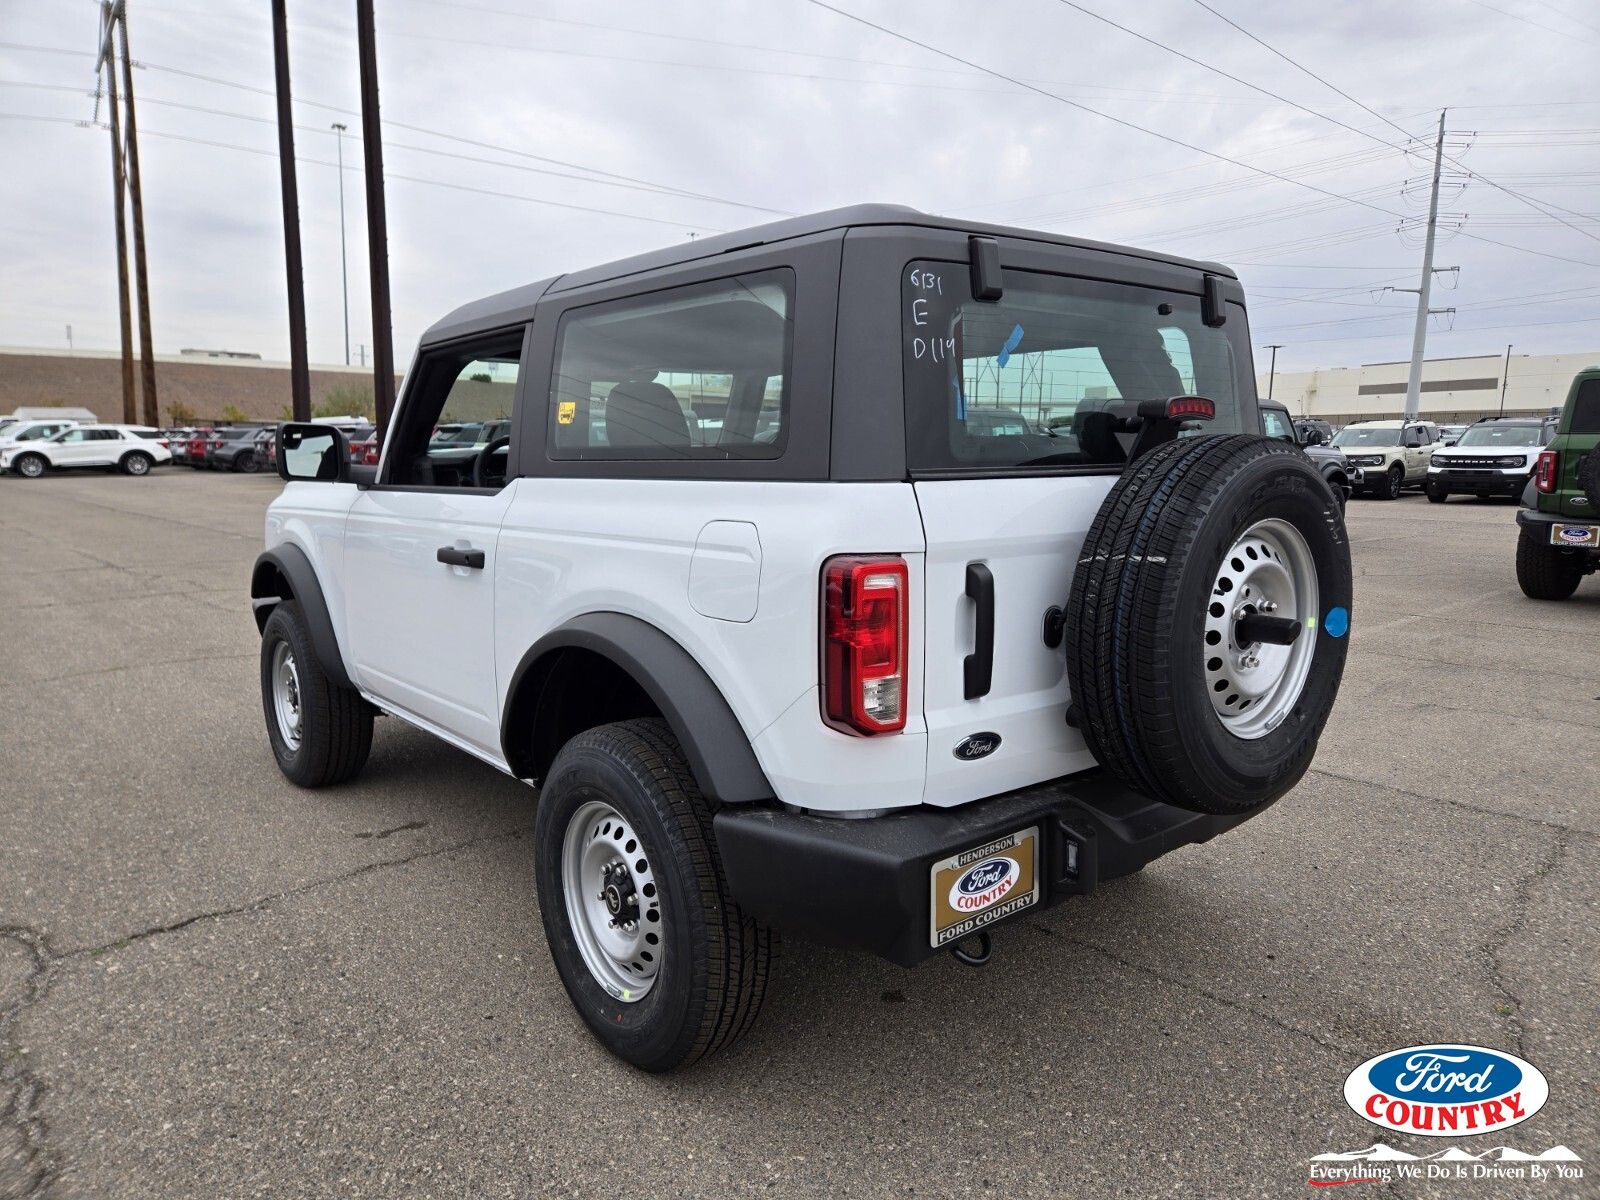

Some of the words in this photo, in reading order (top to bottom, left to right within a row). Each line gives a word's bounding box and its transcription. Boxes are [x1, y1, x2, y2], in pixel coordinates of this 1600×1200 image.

[911, 270, 942, 295] 6131
[912, 299, 928, 326] E
[966, 740, 992, 756] Ford
[959, 838, 1014, 865] HENDERSON
[967, 864, 1002, 891] Ford
[957, 875, 1013, 909] COUNTRY
[939, 920, 974, 943] FORD
[975, 894, 1033, 926] COUNTRY
